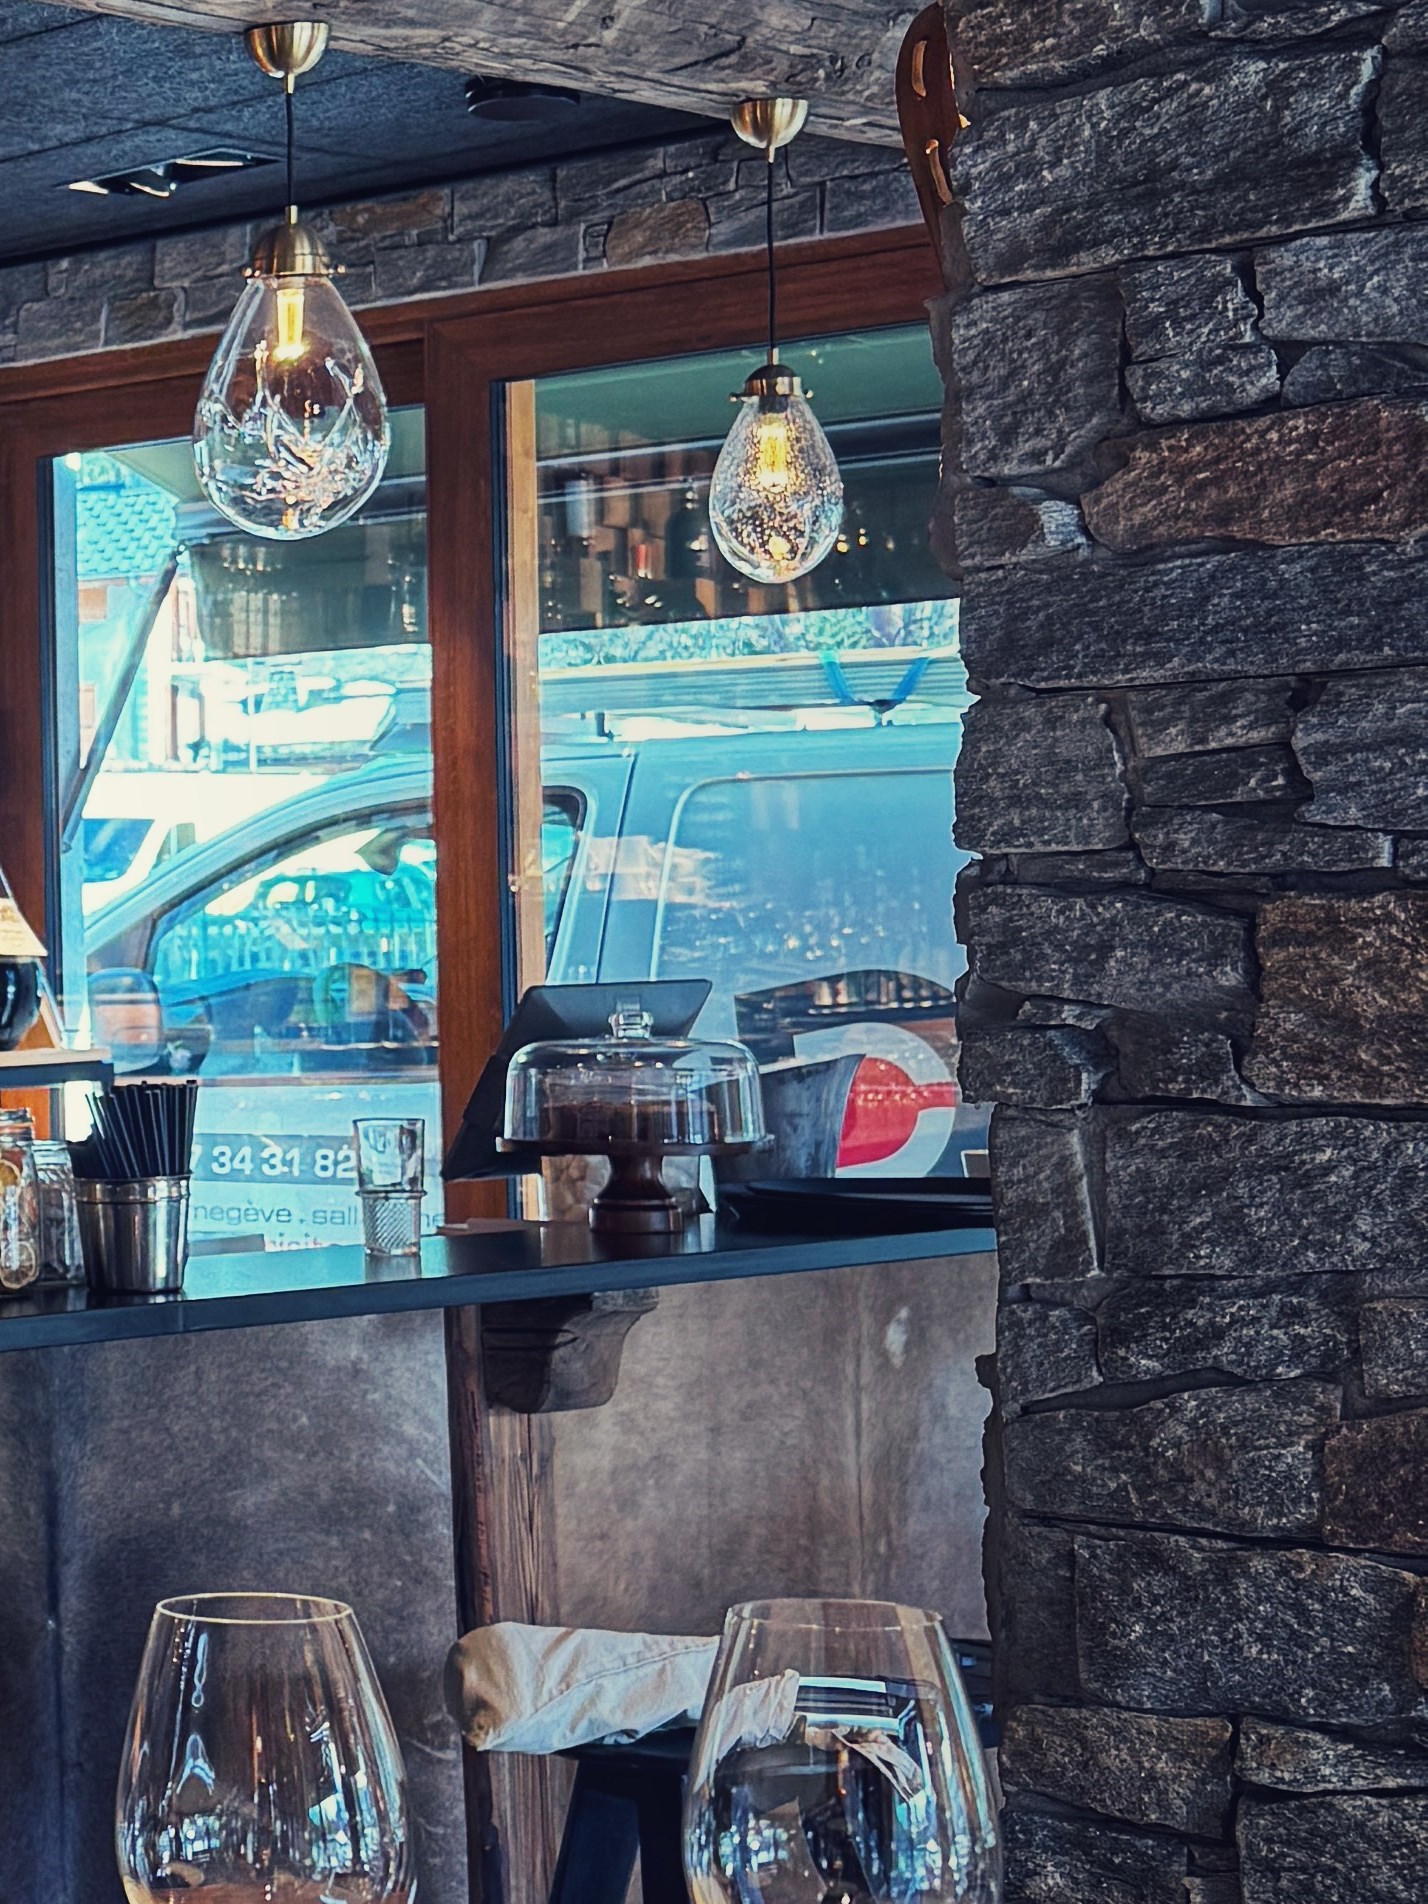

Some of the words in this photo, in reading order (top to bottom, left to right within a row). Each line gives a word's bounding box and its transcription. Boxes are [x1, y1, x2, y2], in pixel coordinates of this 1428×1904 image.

[211, 1145, 254, 1175] 34
[260, 1146, 301, 1177] 31
[314, 1146, 357, 1179] 82
